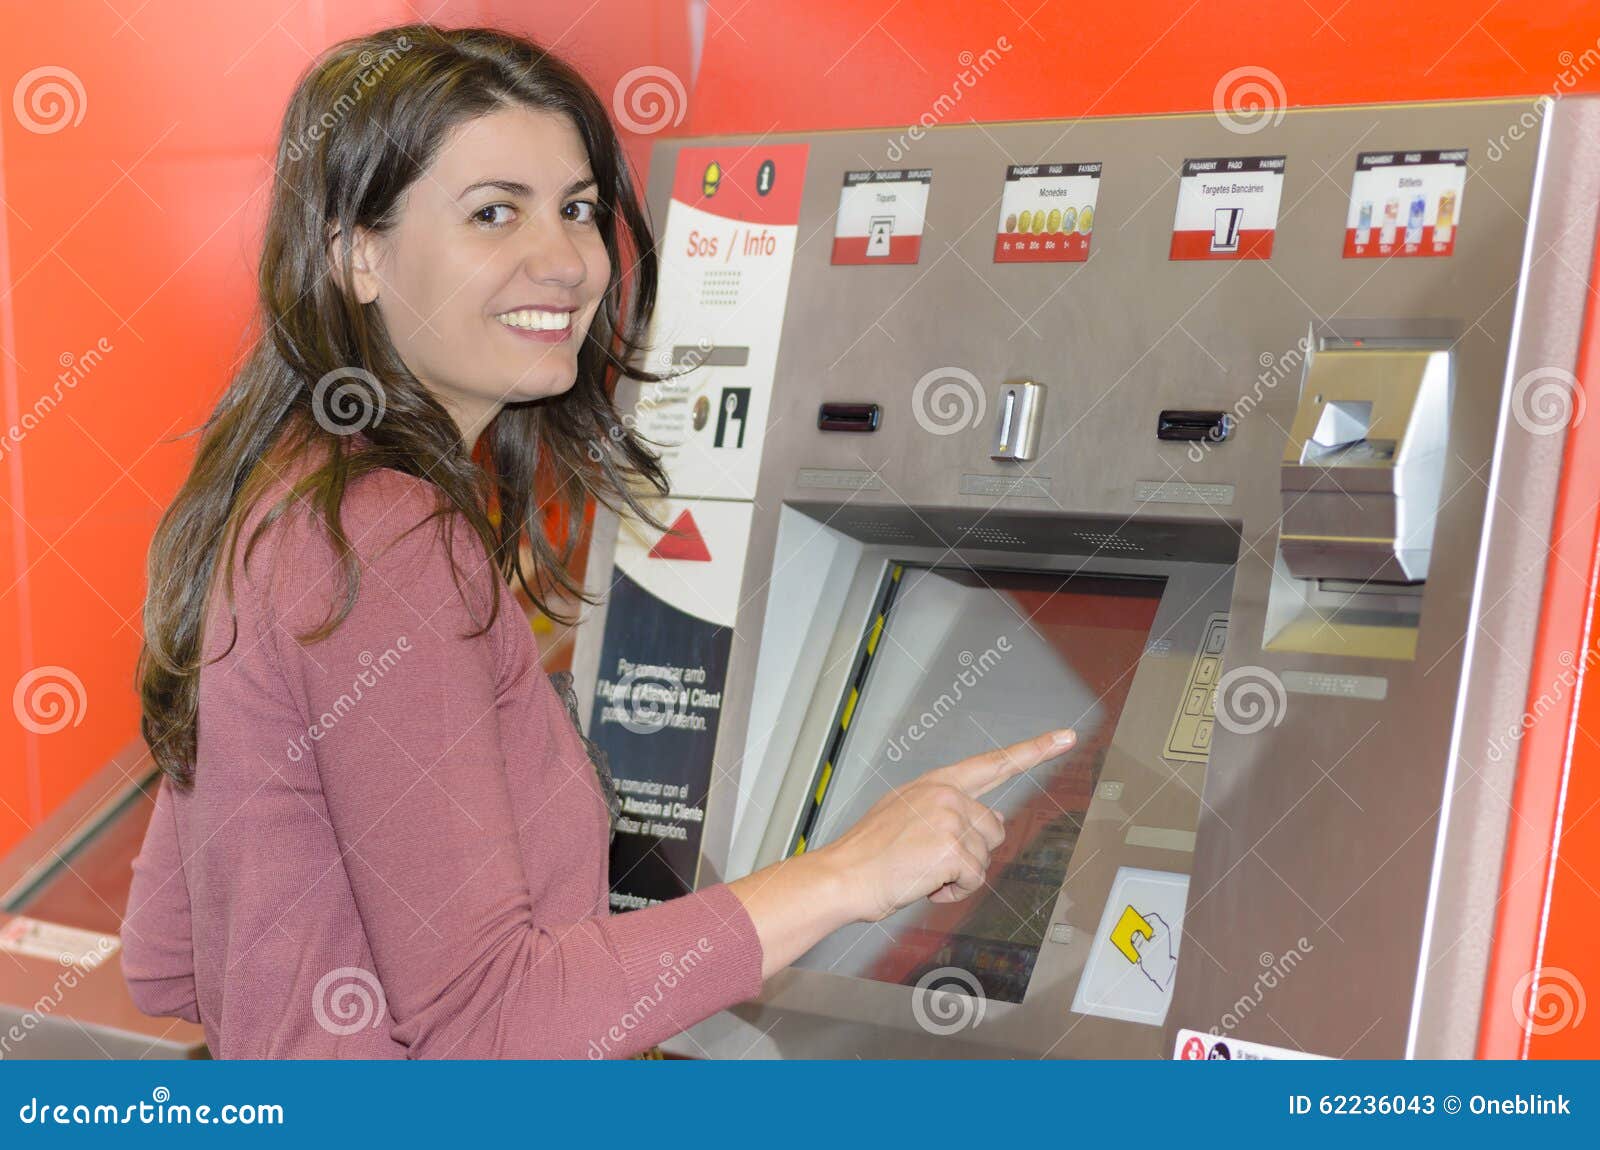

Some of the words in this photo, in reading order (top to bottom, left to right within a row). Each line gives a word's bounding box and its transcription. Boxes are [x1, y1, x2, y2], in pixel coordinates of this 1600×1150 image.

[1227, 160, 1243, 169] PAGO
[1259, 159, 1284, 168] PAYMENT
[1039, 188, 1068, 197] Monedes
[1202, 184, 1231, 196] Targetes
[687, 230, 718, 257] Sos
[744, 230, 776, 256] Info
[684, 666, 706, 683] amb
[691, 688, 720, 709] Client
[621, 779, 663, 796] comunicar
[663, 784, 679, 799] con
[680, 784, 690, 799] el
[624, 796, 662, 816] Atención
[662, 800, 672, 817] al
[672, 802, 704, 822] Cliente
[641, 820, 651, 835] el
[650, 820, 688, 840] interfono.
